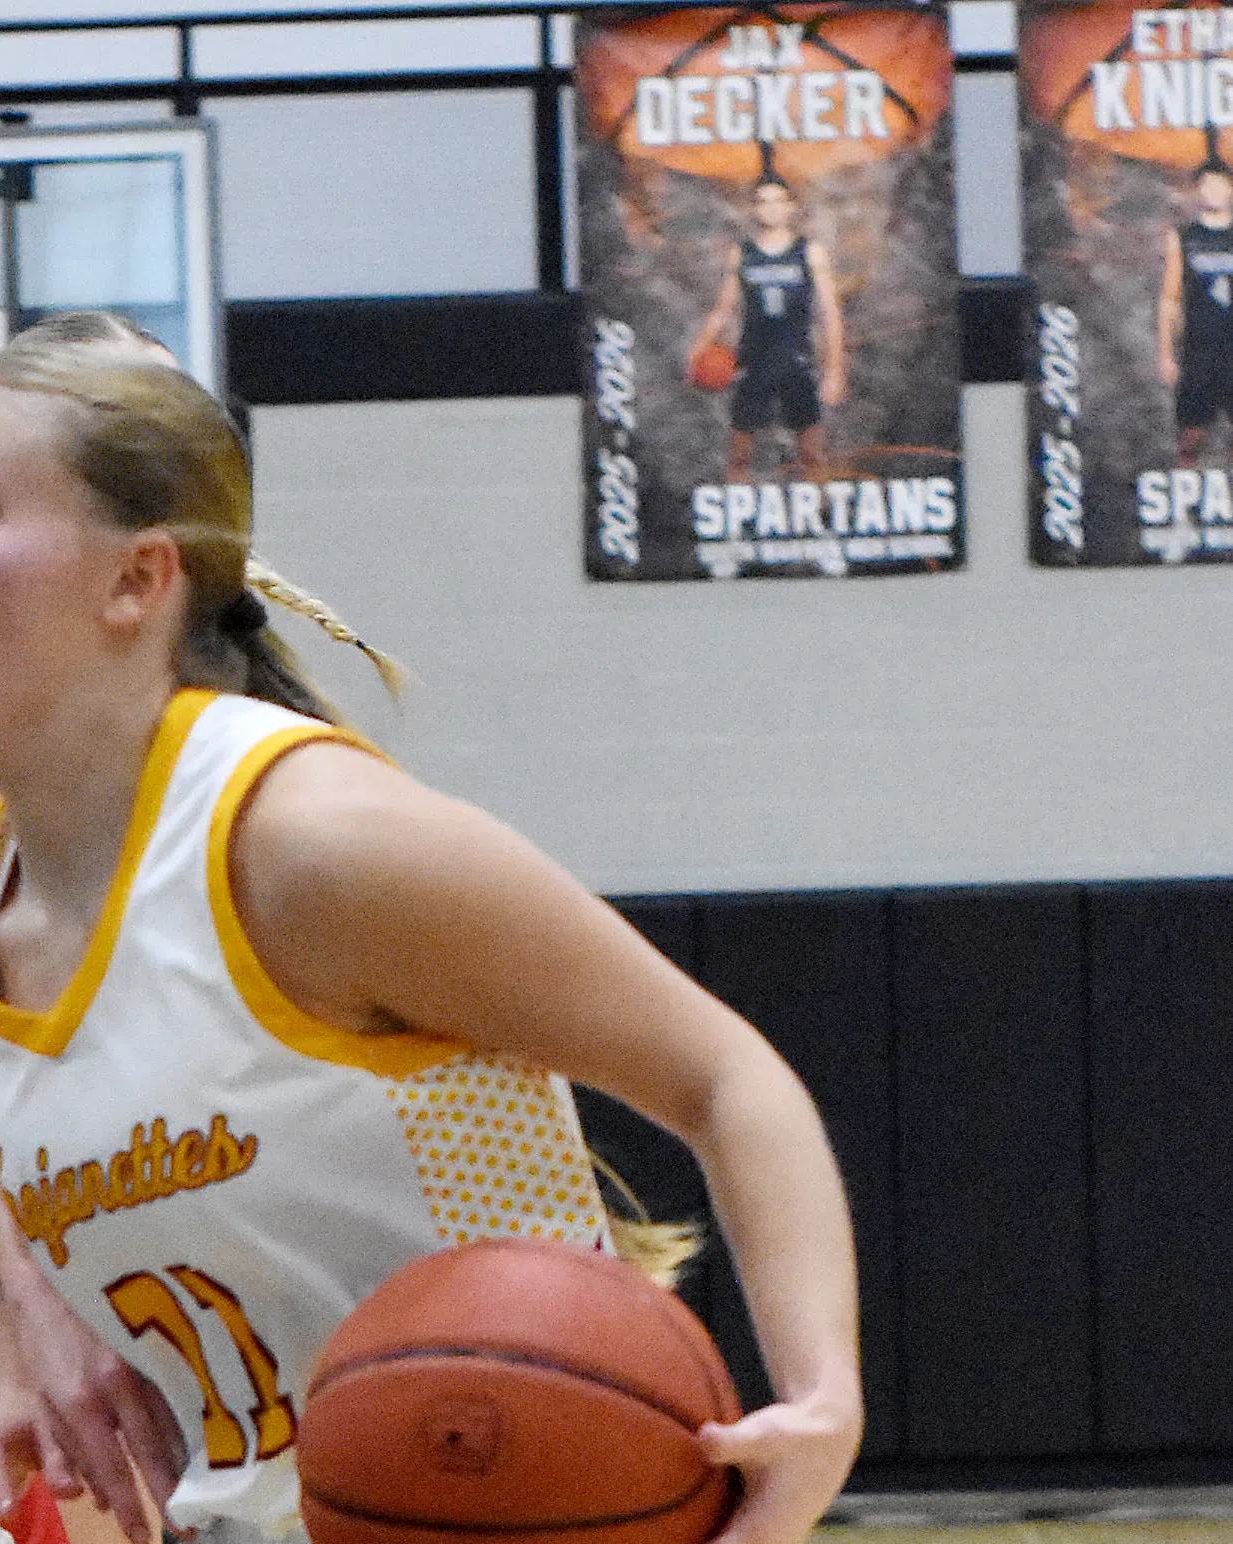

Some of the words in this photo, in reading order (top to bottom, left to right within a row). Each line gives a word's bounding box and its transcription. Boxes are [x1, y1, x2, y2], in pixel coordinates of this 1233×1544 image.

[719, 22, 807, 69] JAX
[636, 68, 891, 147] DECKER
[692, 476, 959, 543] SPARTANS
[101, 1263, 300, 1471] 11
